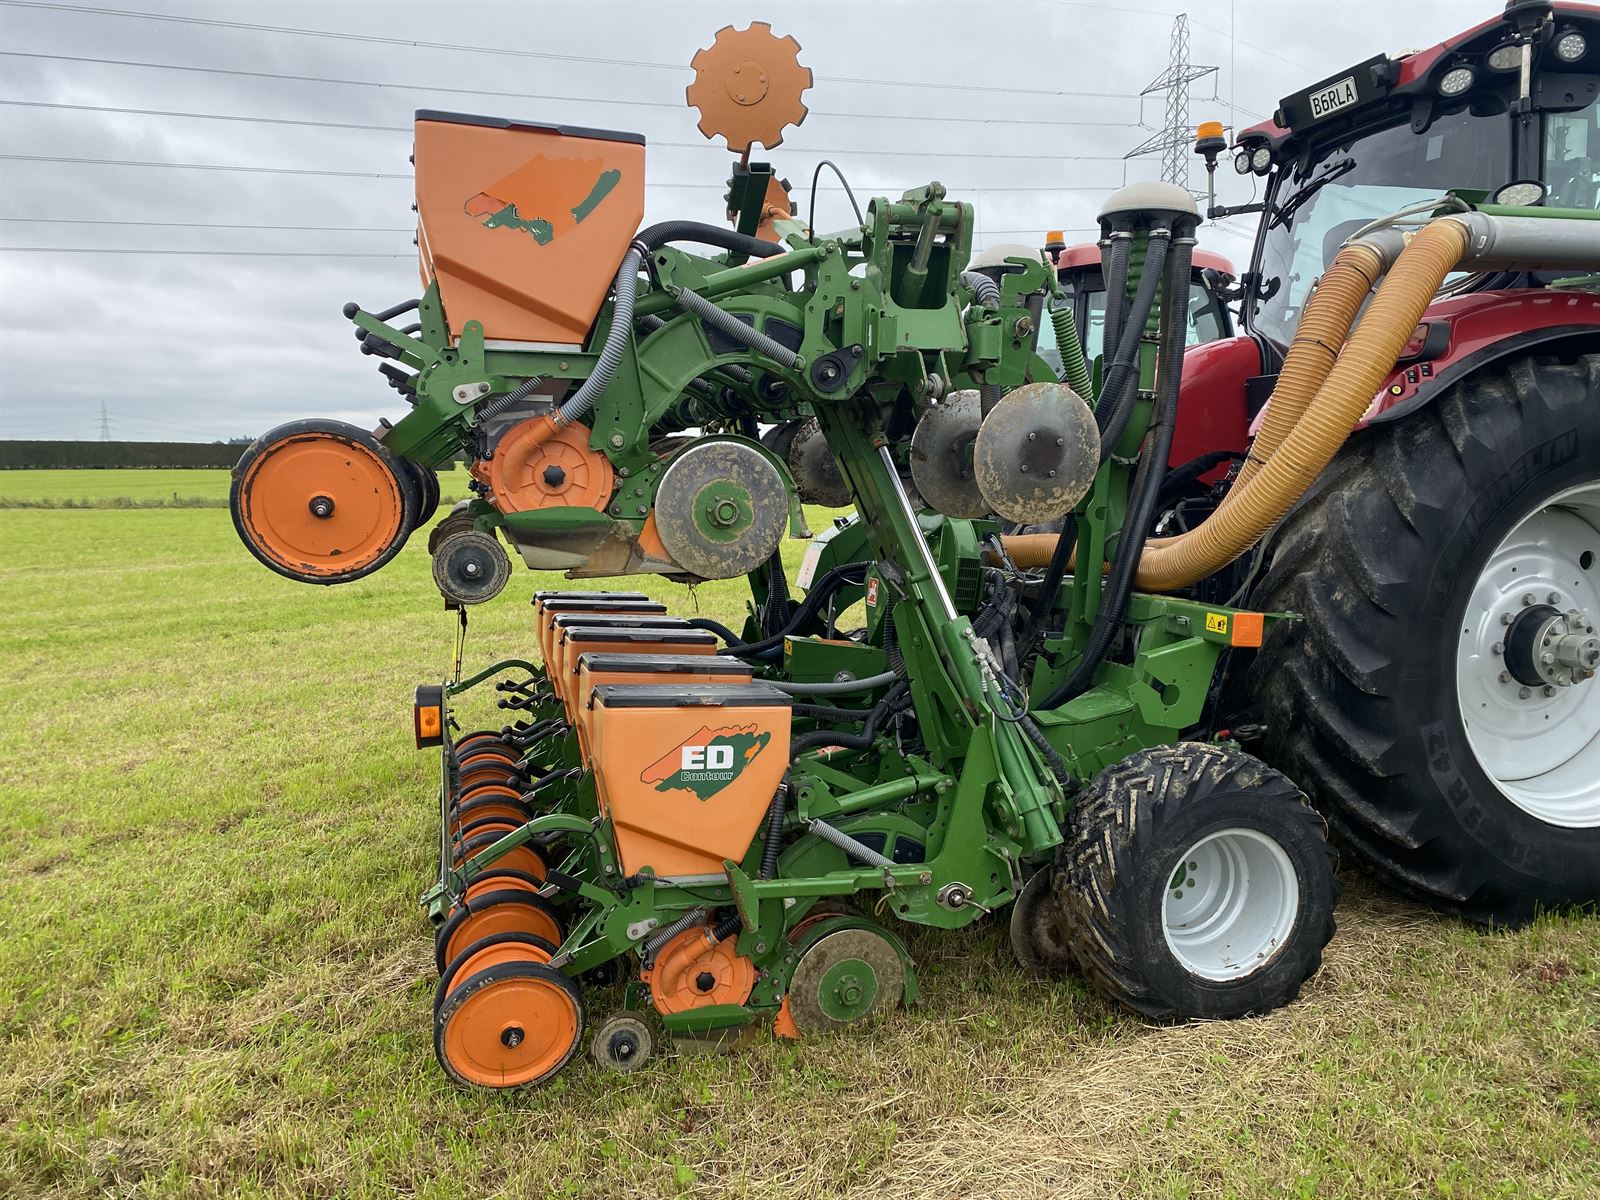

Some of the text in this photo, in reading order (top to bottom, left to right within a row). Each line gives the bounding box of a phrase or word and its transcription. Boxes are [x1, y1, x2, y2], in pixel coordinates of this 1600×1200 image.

[1312, 83, 1355, 115] B6RLA
[681, 745, 734, 769] ED
[681, 772, 733, 781] Contour
